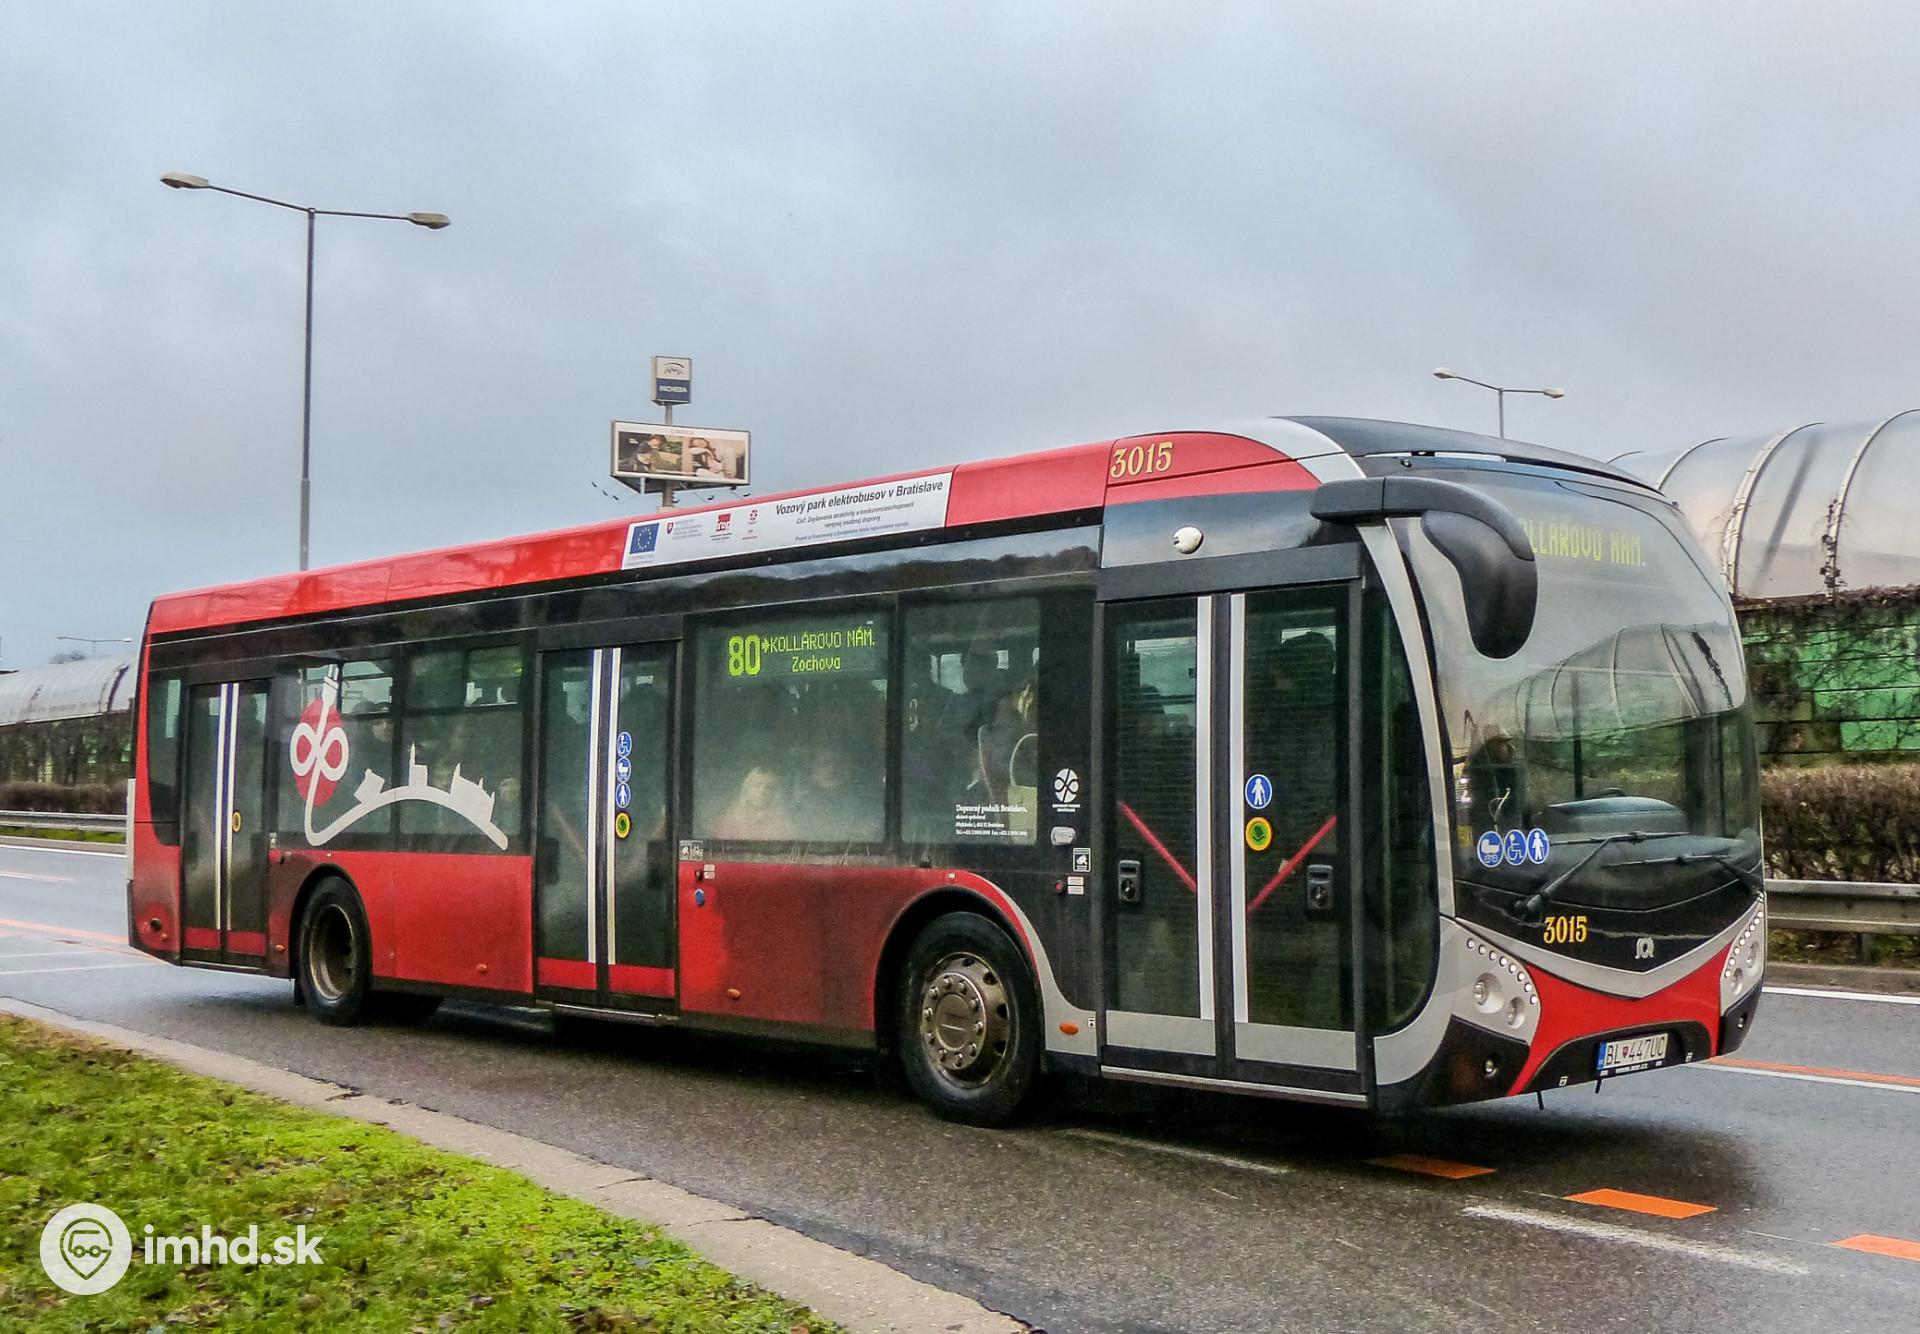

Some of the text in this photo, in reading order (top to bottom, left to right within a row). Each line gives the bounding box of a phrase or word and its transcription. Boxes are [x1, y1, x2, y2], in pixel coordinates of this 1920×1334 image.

[1110, 441, 1173, 478] 3015
[776, 481, 943, 516] Vozový park elektrobusov v Bratislave
[770, 625, 875, 653] KOLLÁROVO NÁM.
[728, 635, 761, 676] 80
[791, 655, 841, 673] Zochova
[1543, 915, 1587, 944] 3015
[1605, 1044, 1620, 1065] BL
